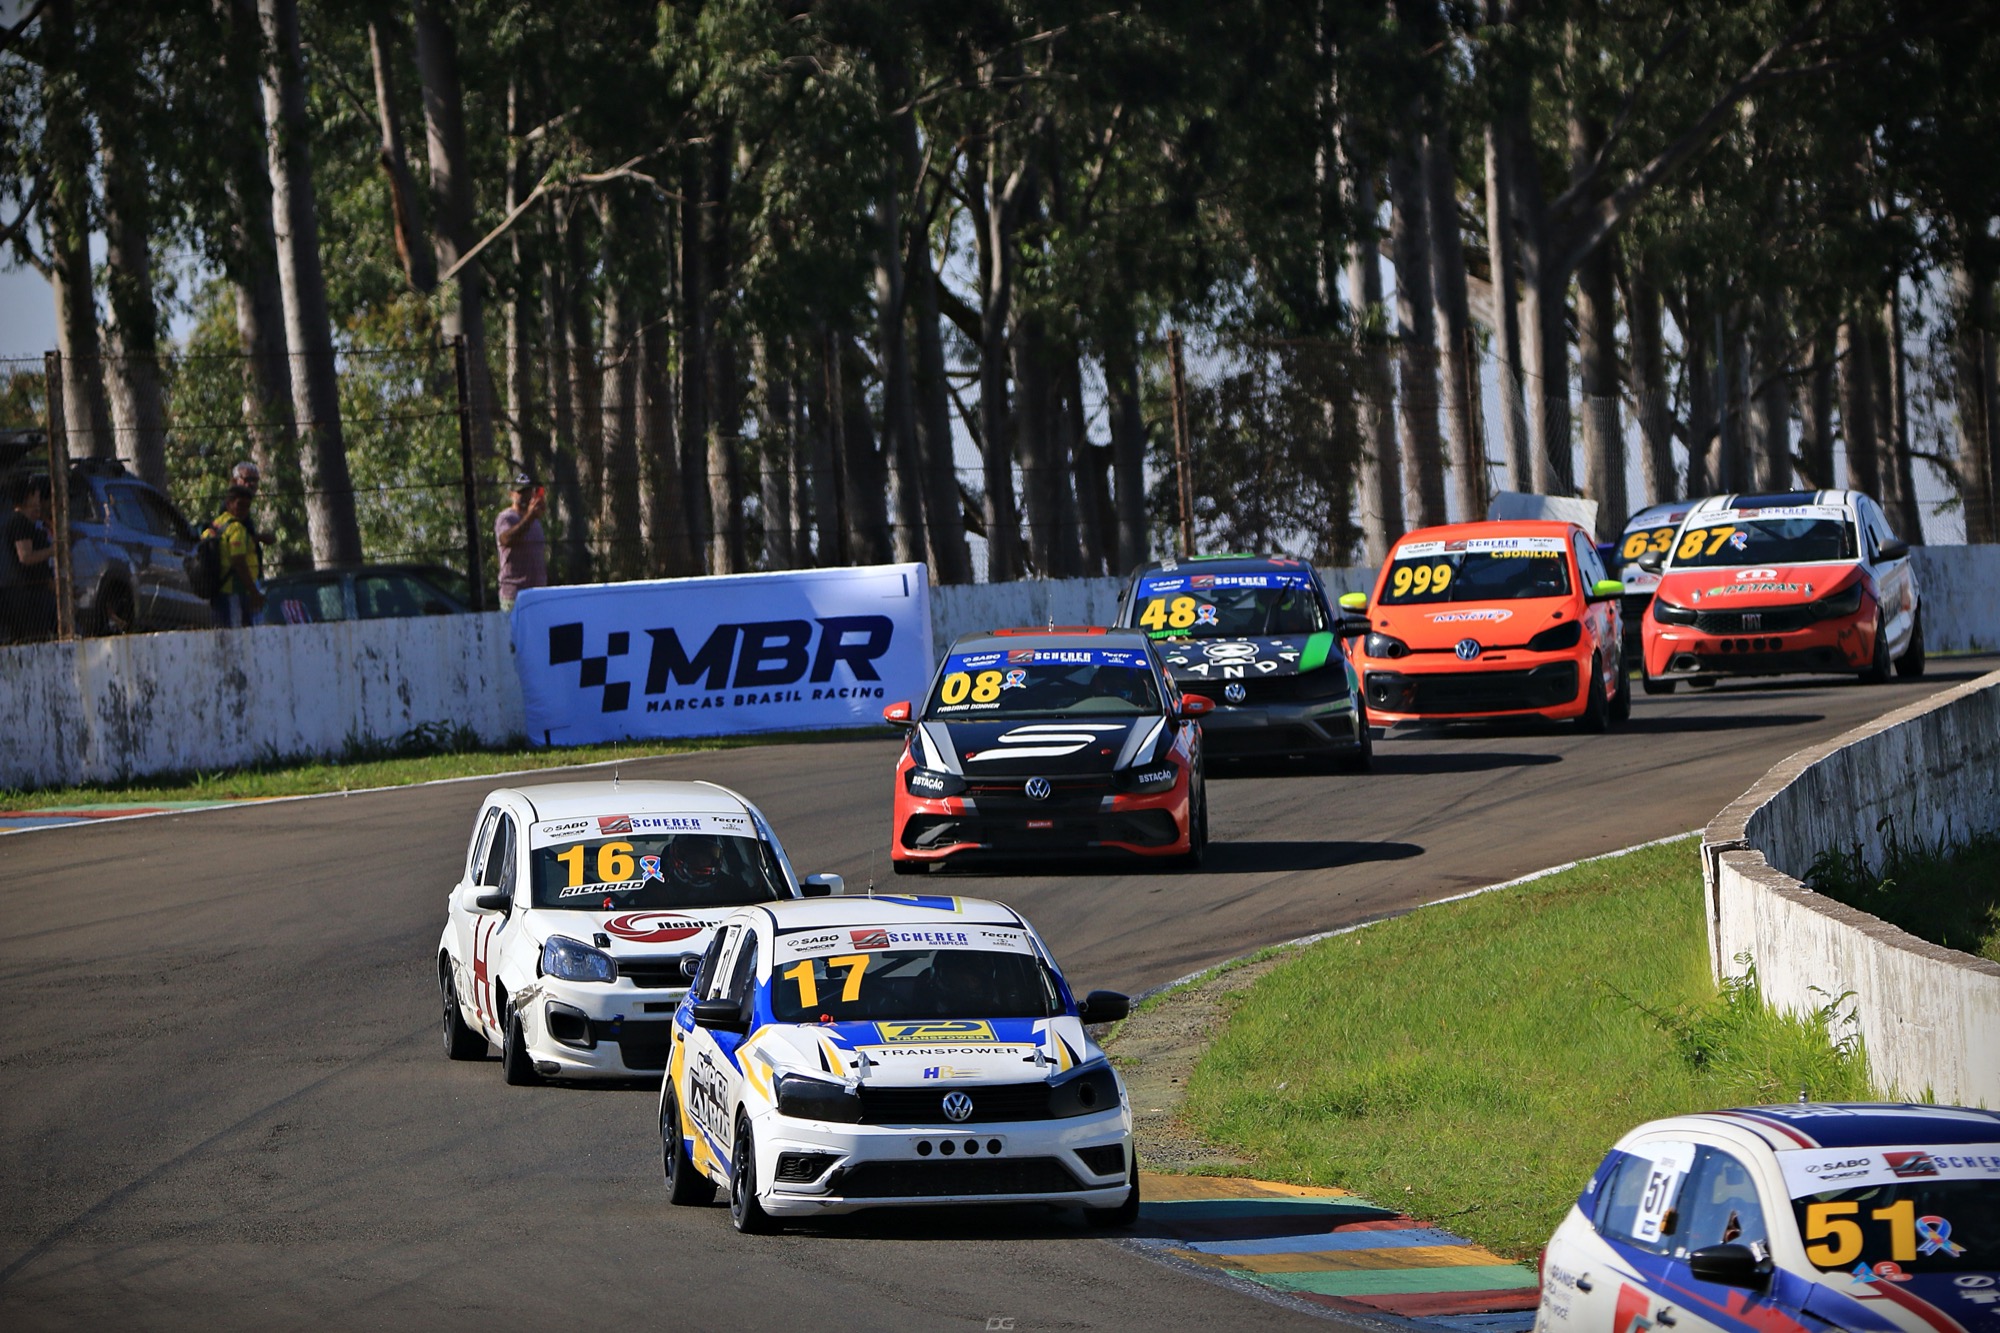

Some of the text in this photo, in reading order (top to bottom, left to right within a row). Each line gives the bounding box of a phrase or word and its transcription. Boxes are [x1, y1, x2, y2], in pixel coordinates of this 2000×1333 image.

[1468, 540, 1519, 548] SCHERER
[1623, 528, 1675, 560] 63
[1677, 526, 1737, 560] 87
[1393, 564, 1452, 597] 999
[1140, 596, 1196, 630] 48
[644, 615, 894, 695] MBR
[1034, 652, 1092, 661] SCHERER
[647, 687, 885, 713] MARCAS BRASIL RACING
[942, 670, 1003, 705] 08
[632, 818, 701, 828] SCHERER
[712, 816, 745, 824] Tecfil
[557, 841, 635, 887] 16
[561, 880, 645, 897] RICHARD
[890, 932, 968, 943] SCHERER
[980, 931, 1017, 939] Tecfil
[784, 954, 870, 1009] 17
[879, 1048, 1019, 1056] TRANSPOWER
[1644, 1172, 1672, 1215] 51
[1806, 1200, 1917, 1267] 51
